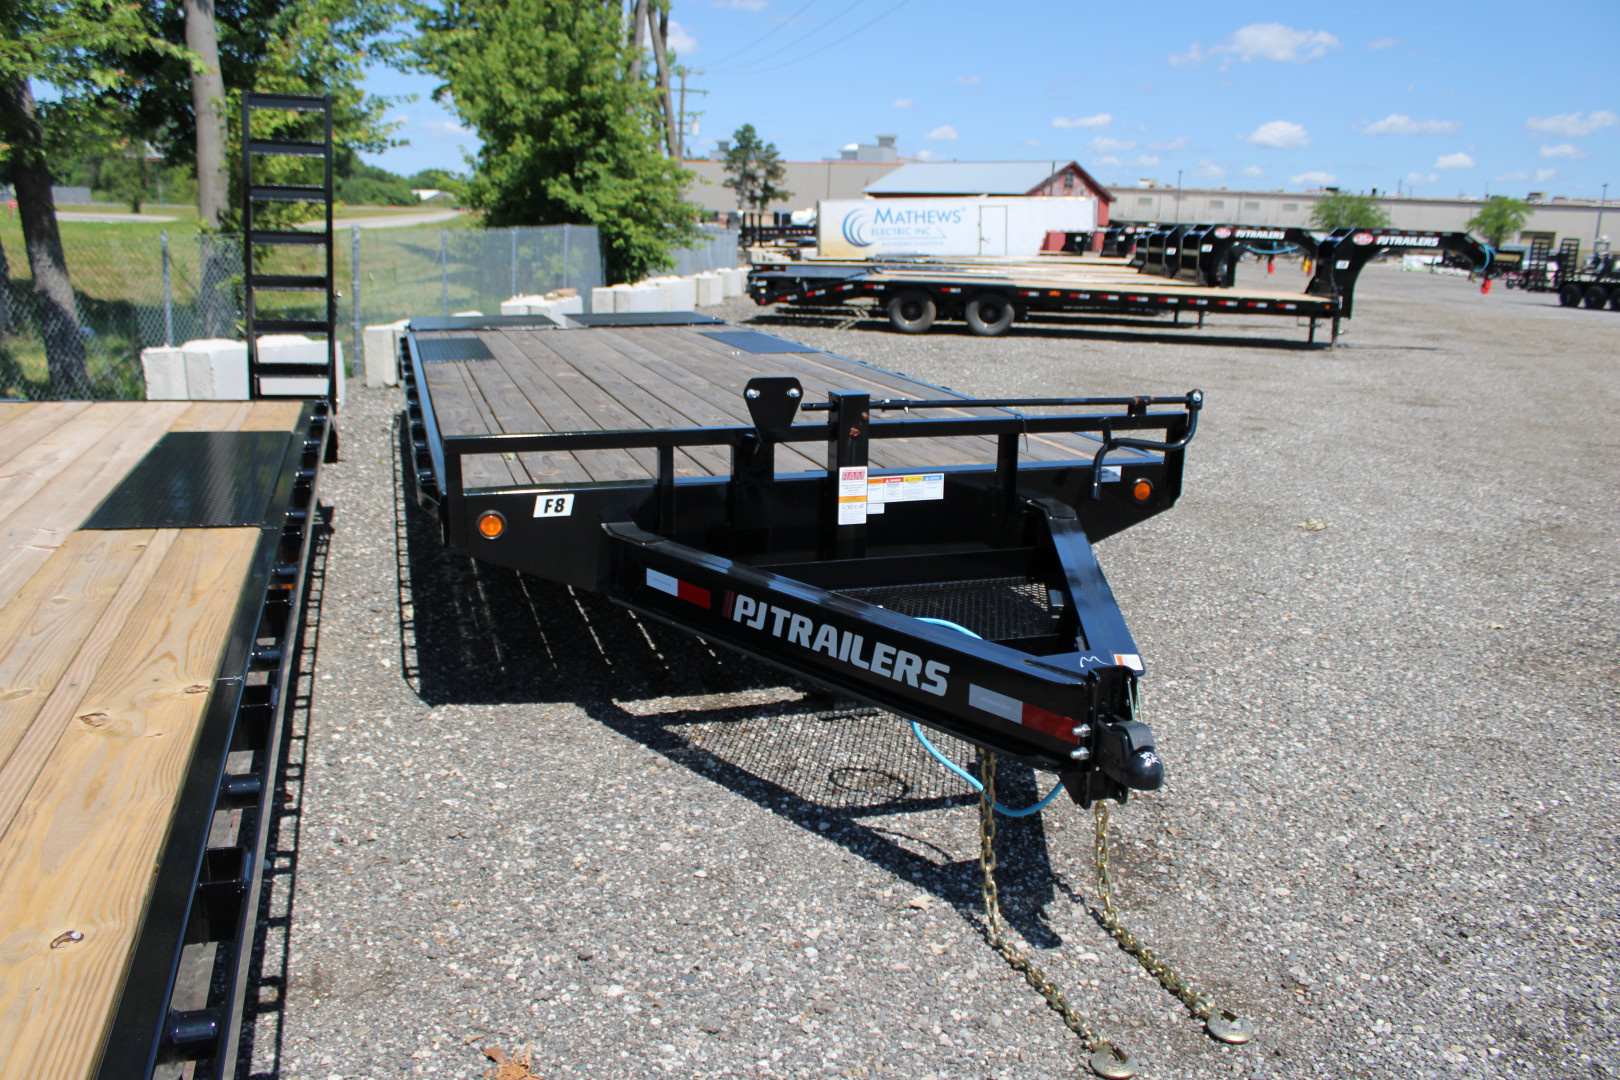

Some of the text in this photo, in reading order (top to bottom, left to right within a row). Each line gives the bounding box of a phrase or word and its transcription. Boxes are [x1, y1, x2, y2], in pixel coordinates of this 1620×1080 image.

[874, 207, 962, 224] MATHEWS
[871, 227, 931, 236] ELECTRIC INC
[1246, 230, 1286, 240] TRAILERS
[1376, 235, 1390, 246] PJ
[1389, 236, 1440, 247] TRAILERS
[841, 471, 866, 481] RAM
[544, 498, 566, 514] F8
[733, 594, 951, 697] PJ TRAILERS
